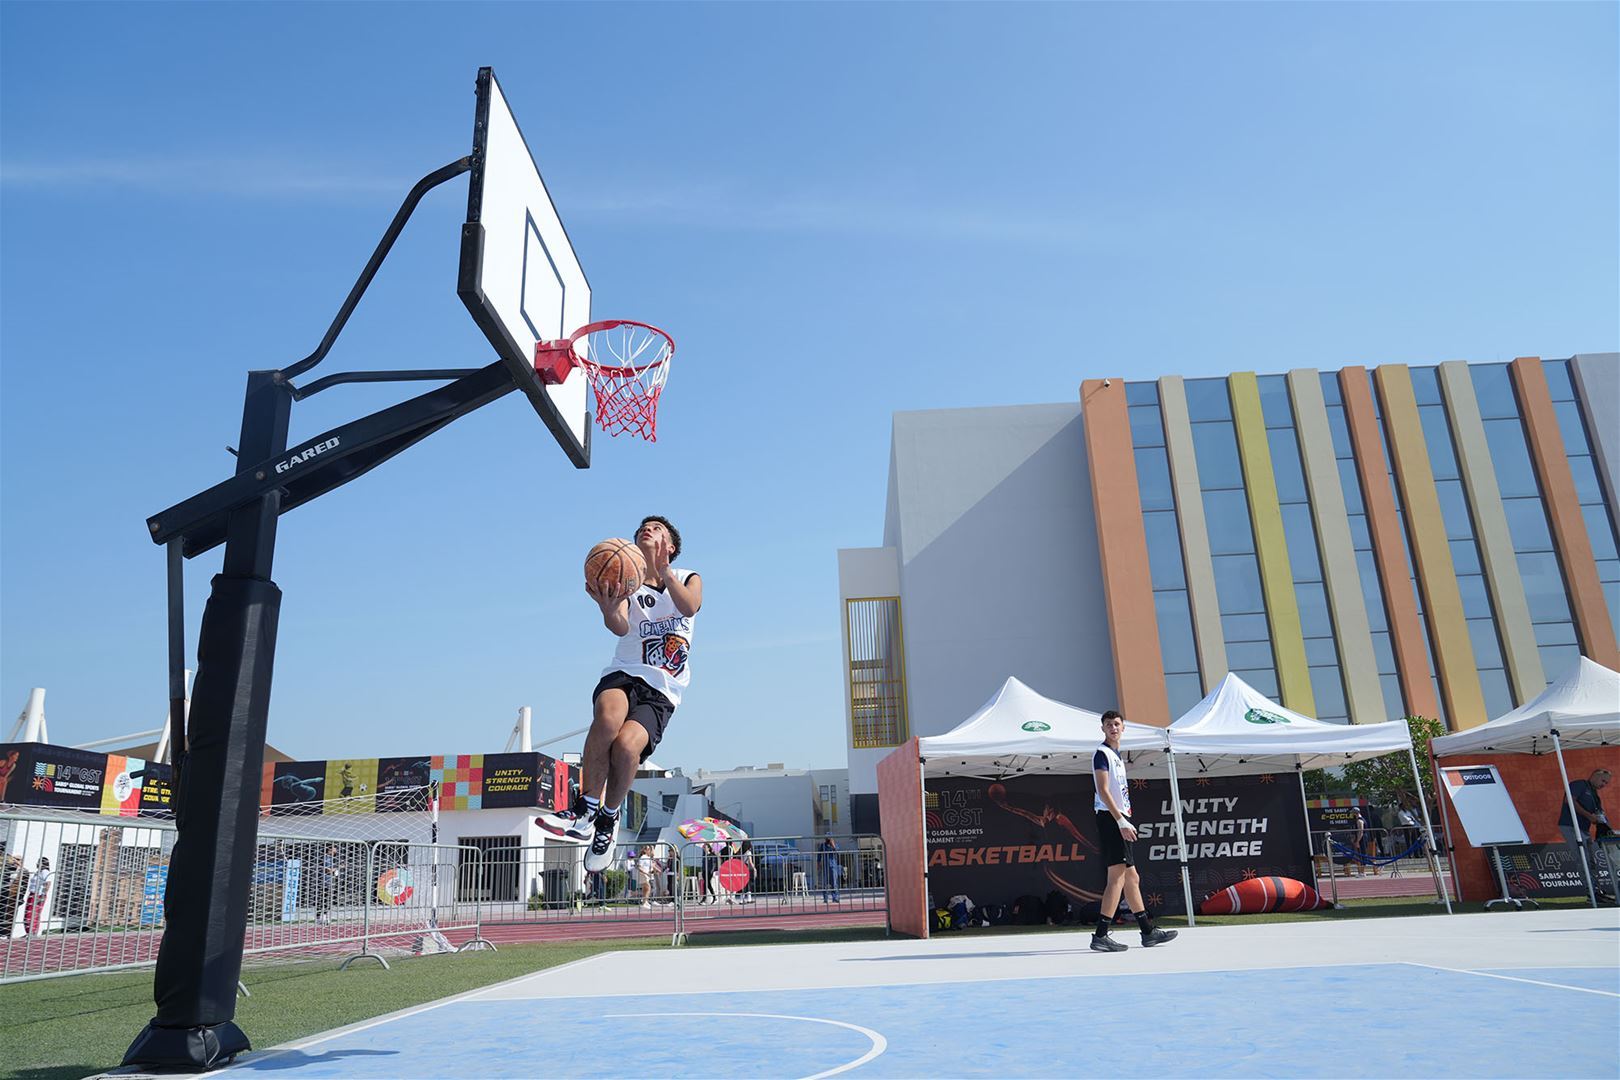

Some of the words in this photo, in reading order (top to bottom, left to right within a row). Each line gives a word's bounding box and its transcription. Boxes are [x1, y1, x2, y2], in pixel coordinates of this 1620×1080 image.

[275, 437, 340, 473] GARED
[637, 594, 655, 609] 10
[79, 767, 102, 784] GST
[485, 776, 532, 784] STRENGTH
[488, 784, 529, 792] COURAGE
[1161, 797, 1239, 815] UNITY
[942, 808, 983, 826] GST
[929, 843, 1085, 866] ASKETBALL
[1149, 840, 1263, 861] COURAGE
[1541, 880, 1583, 888] TOURNAM
